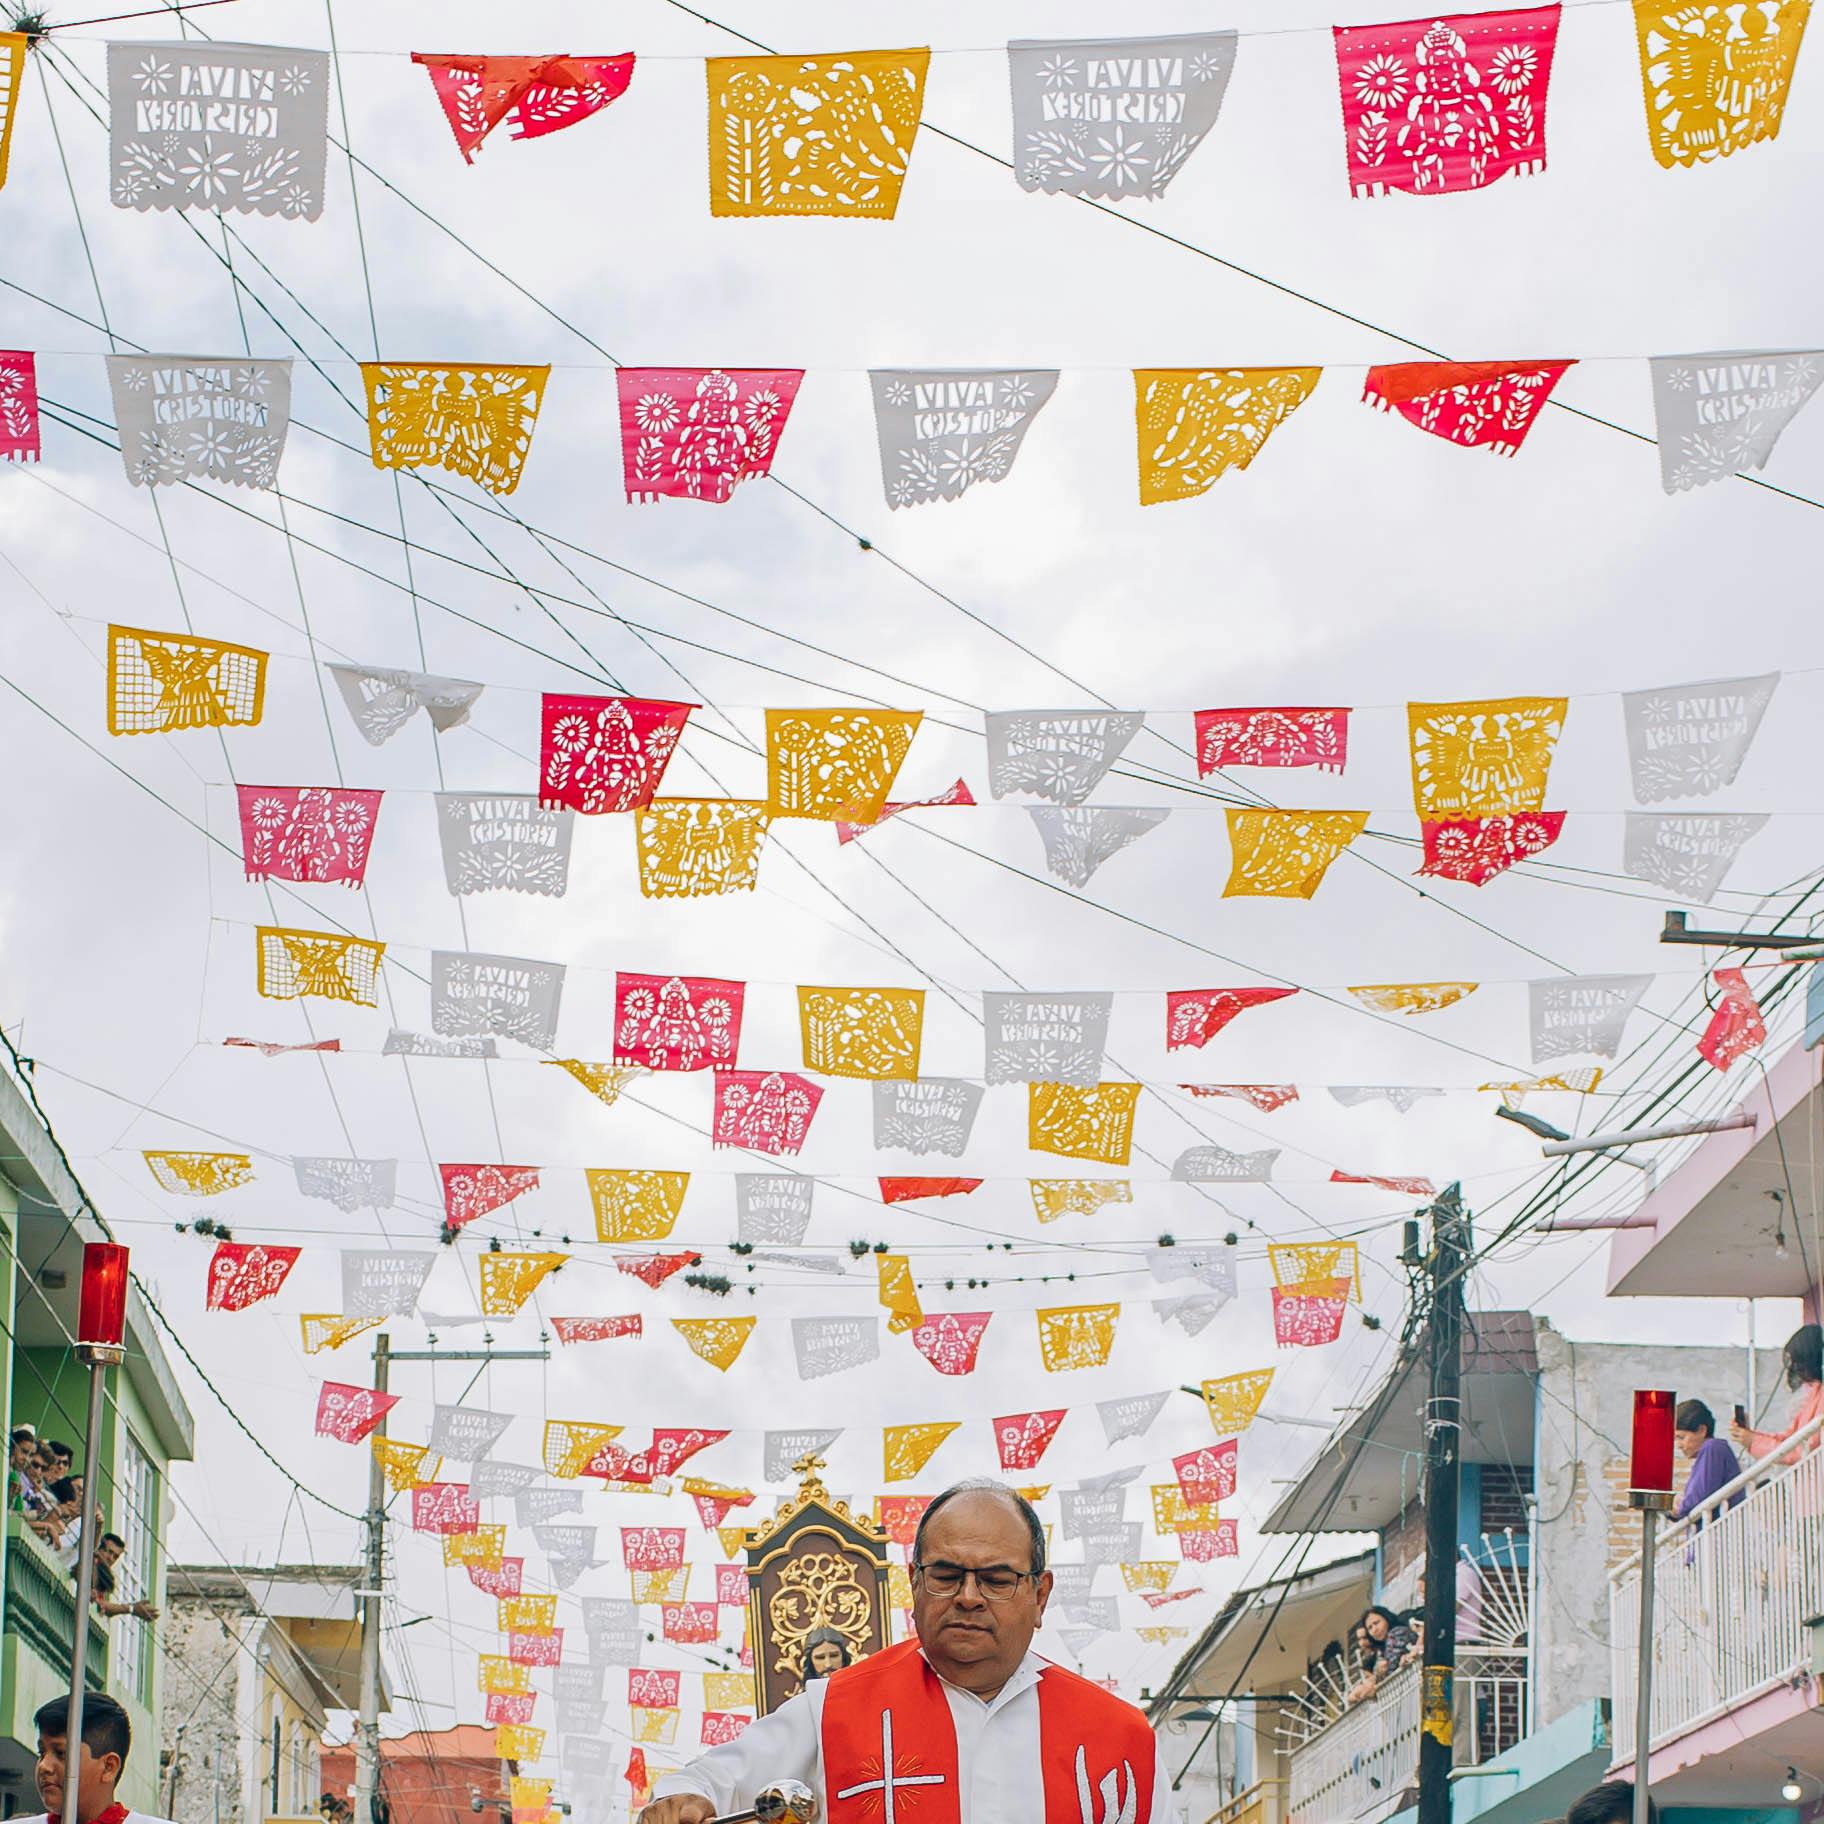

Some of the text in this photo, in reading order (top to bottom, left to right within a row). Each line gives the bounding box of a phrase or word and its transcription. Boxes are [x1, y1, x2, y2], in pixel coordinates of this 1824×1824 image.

[152, 368, 232, 395] VIVA
[1696, 364, 1777, 396] VIVA
[914, 381, 994, 410] VIVA
[469, 799, 531, 821] VIVA
[1660, 819, 1721, 837] VIVA
